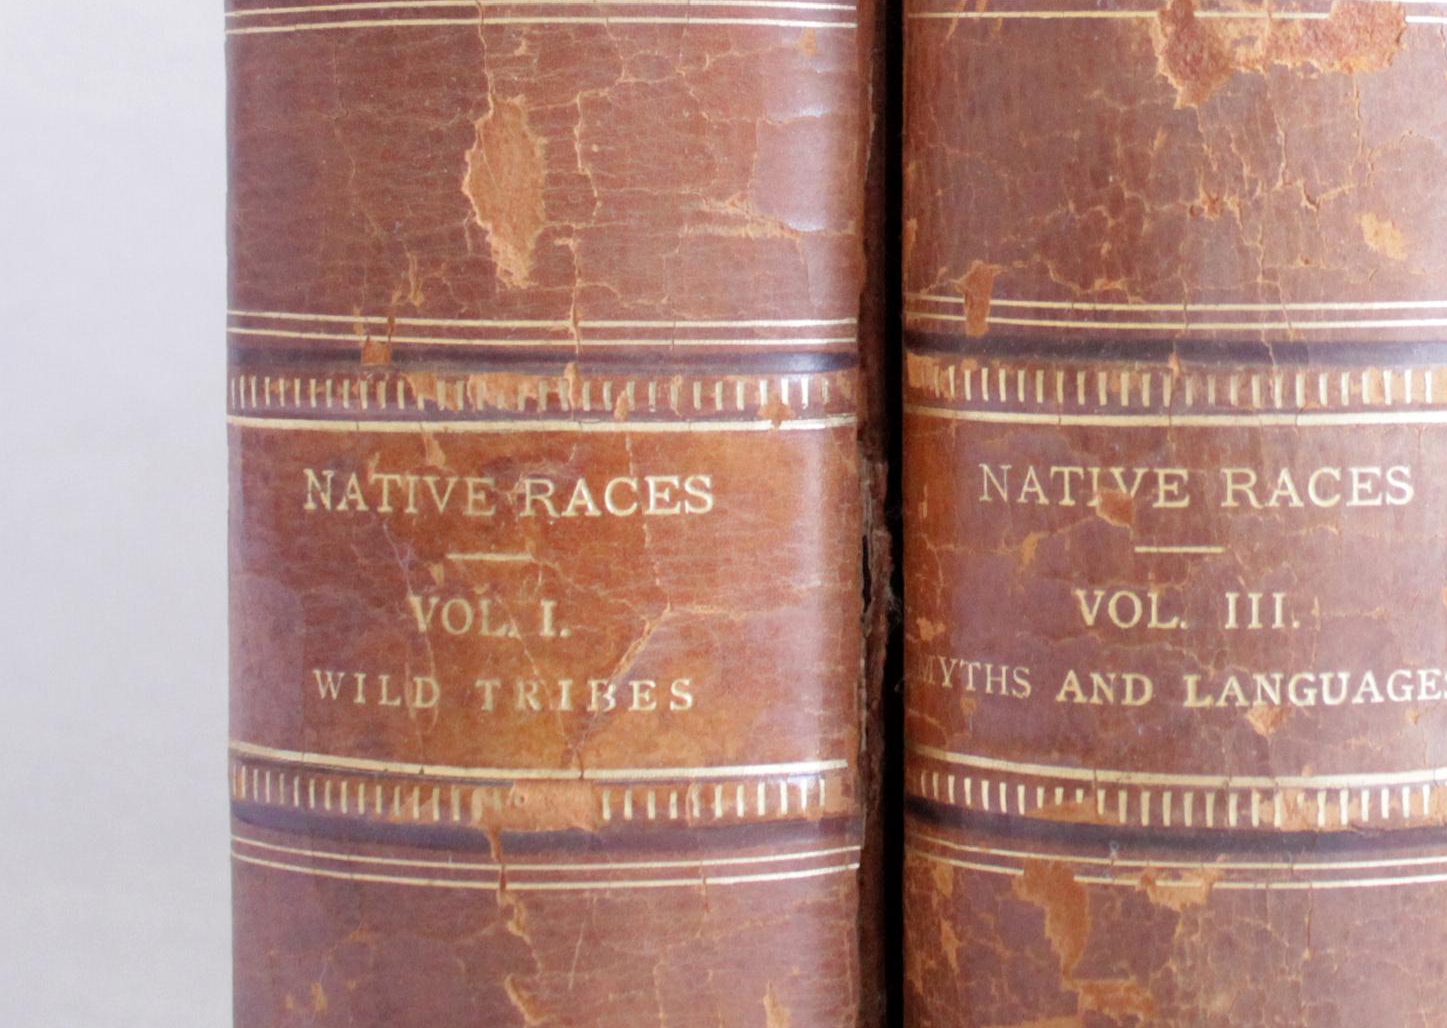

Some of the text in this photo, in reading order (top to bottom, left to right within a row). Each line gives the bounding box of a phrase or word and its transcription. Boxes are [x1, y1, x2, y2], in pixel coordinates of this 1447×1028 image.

[303, 469, 715, 518] NATIVE RACES
[978, 463, 1415, 509] NATIVE RACES
[409, 595, 572, 638] VOL. I.
[1076, 588, 1300, 630] VOL. III.
[313, 669, 694, 712] WILD TRIBES
[1056, 671, 1153, 705] AND
